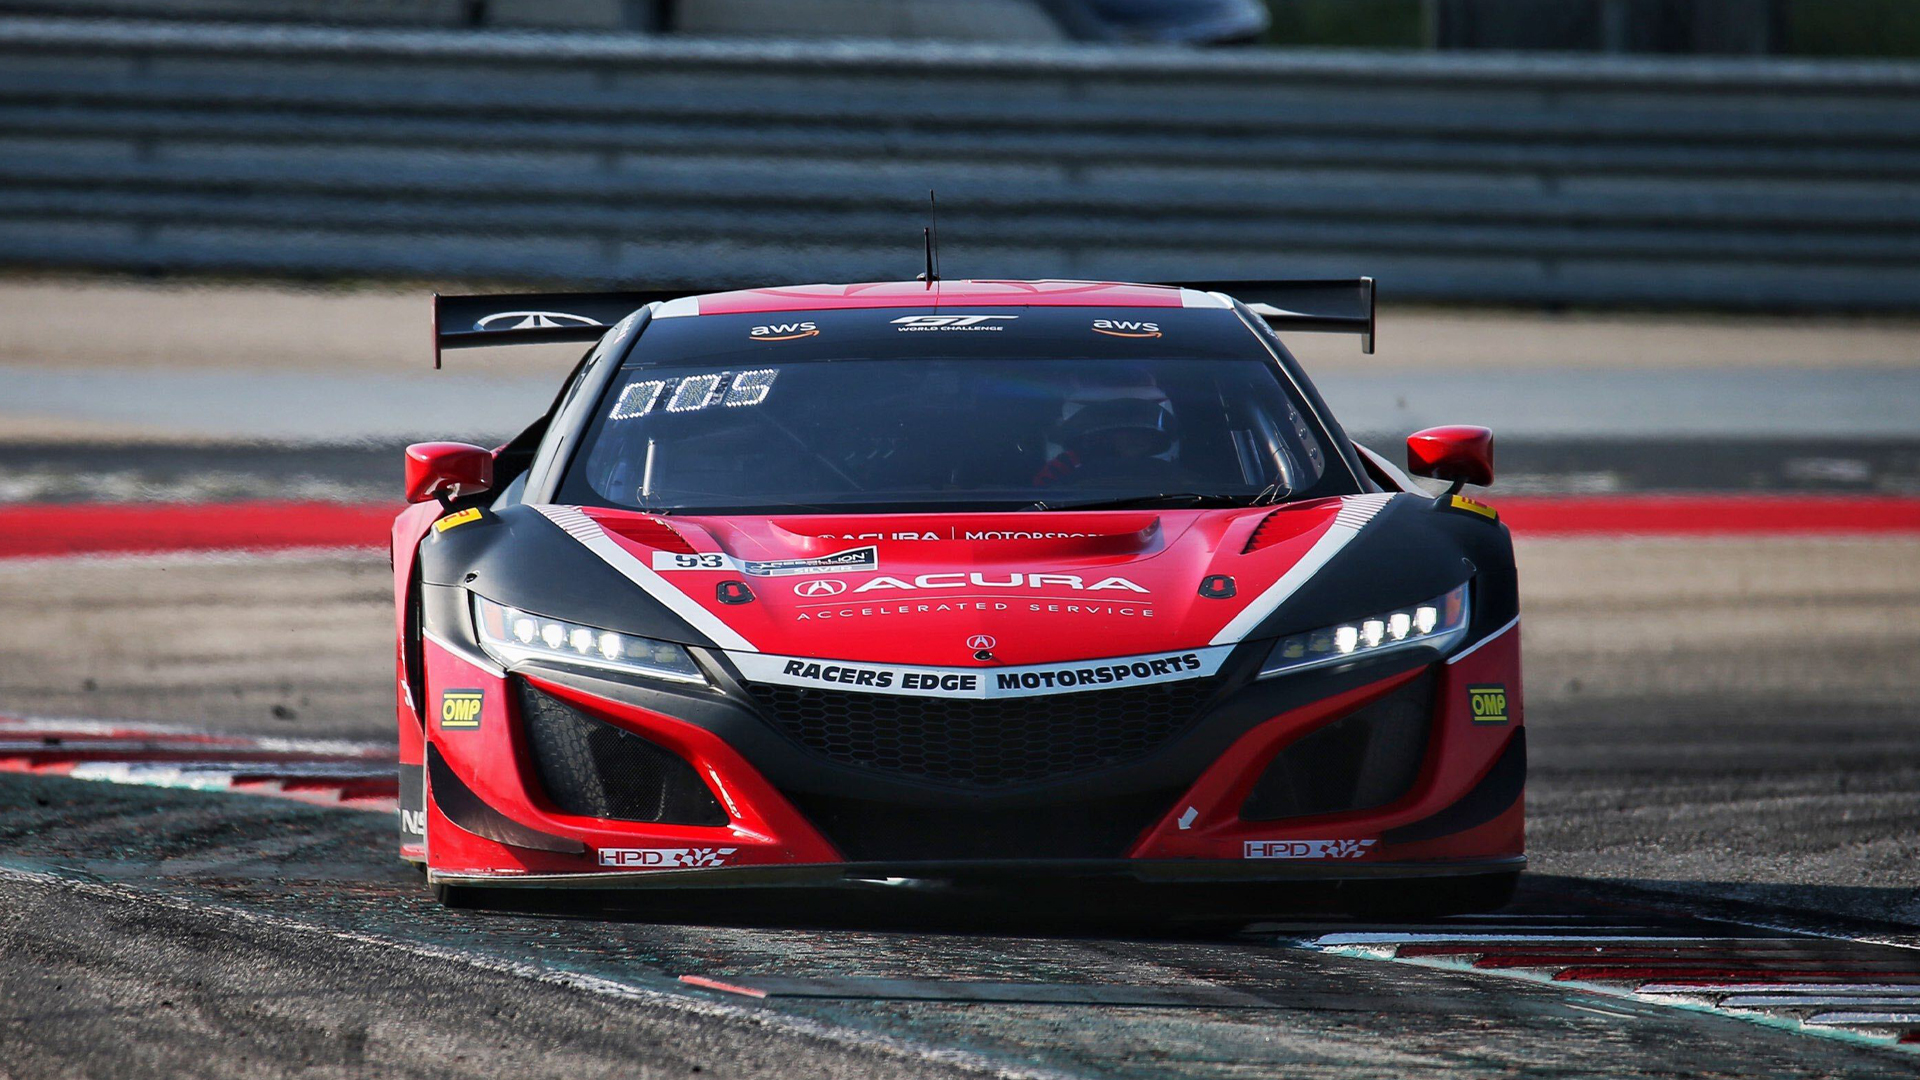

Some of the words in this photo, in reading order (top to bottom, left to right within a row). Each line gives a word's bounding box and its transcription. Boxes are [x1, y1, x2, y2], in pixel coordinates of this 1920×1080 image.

[751, 321, 817, 336] aws
[1093, 319, 1160, 332] aws
[675, 555, 723, 568] 93
[852, 573, 1151, 593] ACURA
[797, 602, 1007, 620] ACCELERATED
[1030, 604, 1153, 617] SERVICE
[783, 660, 893, 687] RACERS
[901, 673, 976, 690] EDGE
[996, 653, 1200, 689] MOTORSPORTS
[442, 699, 481, 720] OMP
[1472, 694, 1506, 715] OMP
[600, 851, 663, 865] HPD
[1245, 843, 1311, 857] HPD
